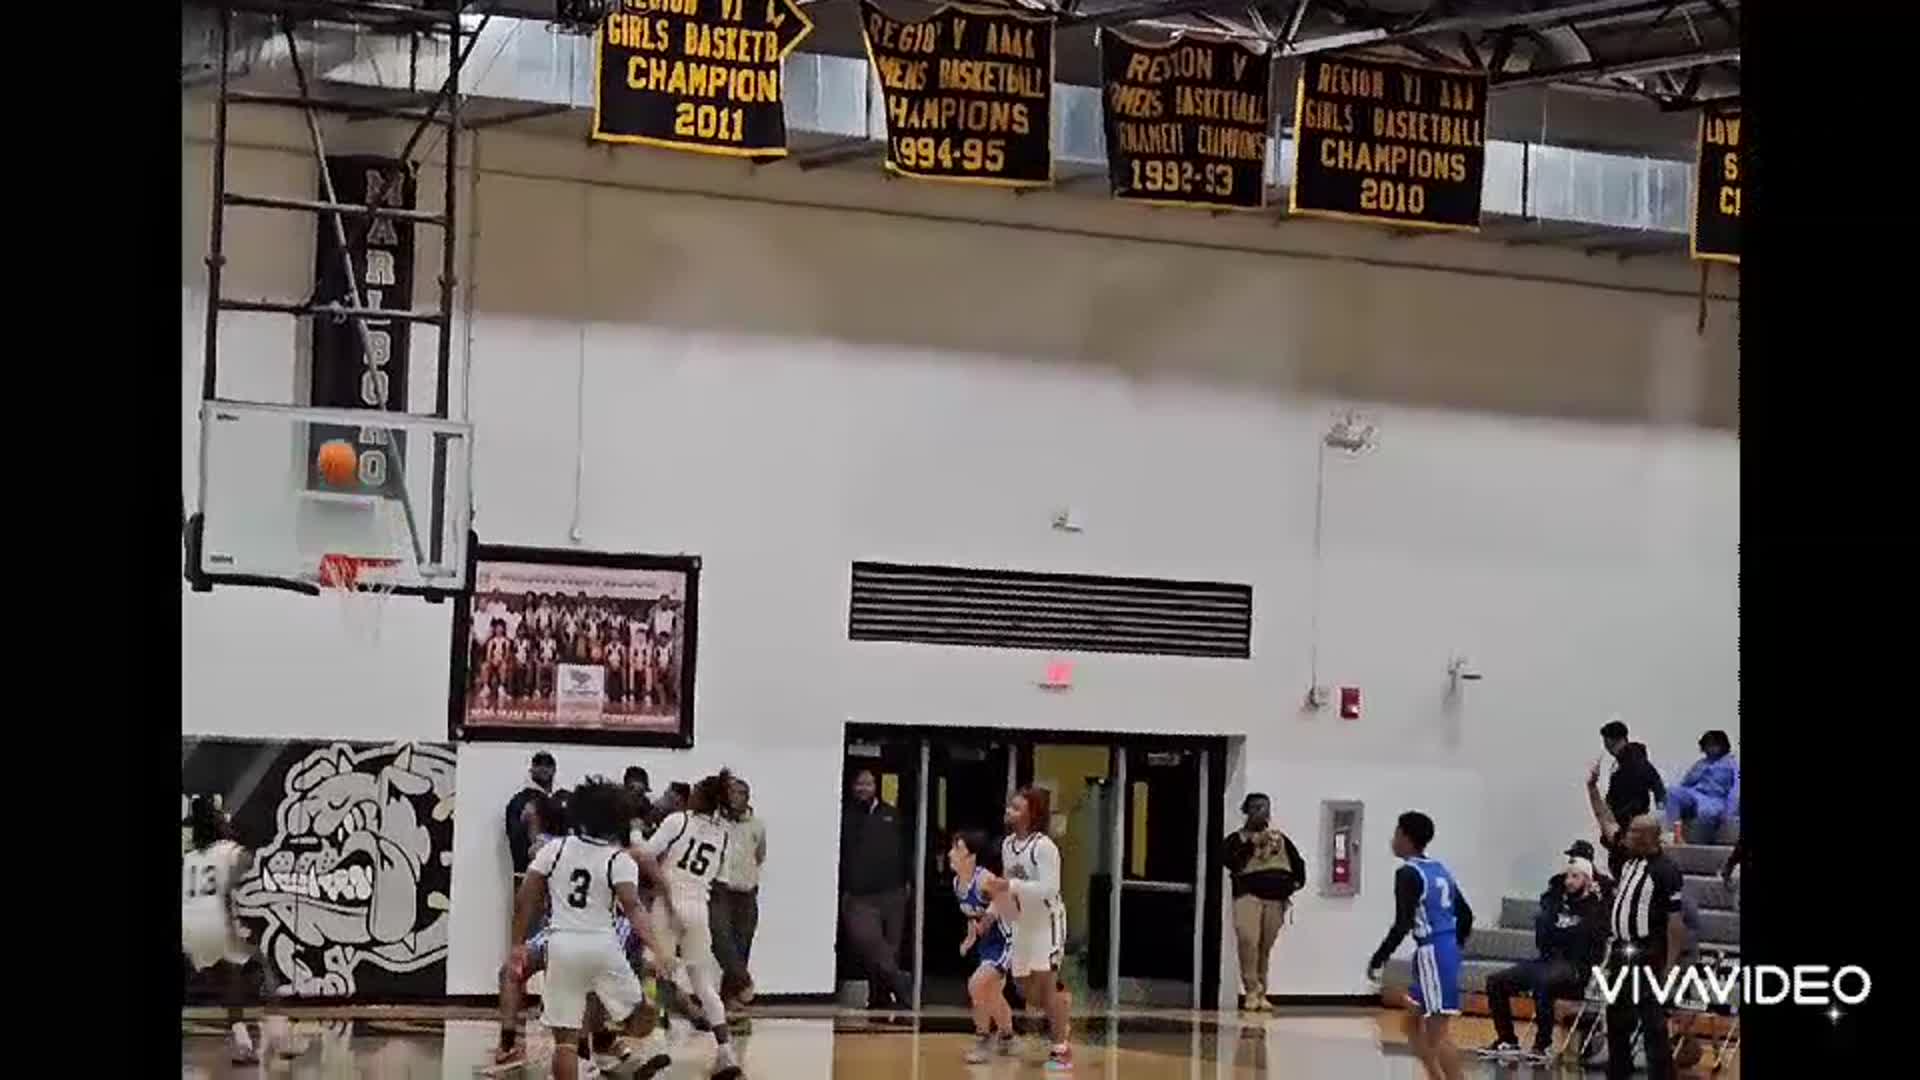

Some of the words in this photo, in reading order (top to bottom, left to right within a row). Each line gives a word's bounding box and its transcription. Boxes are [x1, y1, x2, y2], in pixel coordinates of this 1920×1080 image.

[608, 13, 669, 51] GIRLS
[1317, 62, 1385, 99] REGION
[1402, 73, 1422, 105] VI
[675, 102, 743, 141] 2011
[1305, 99, 1355, 134] GIRLS
[1373, 106, 1482, 147] BASKETBALL
[892, 135, 1005, 172] 1994-95
[1320, 137, 1467, 182] CHAMPIONS
[1131, 158, 1234, 196] 1992-93
[1360, 177, 1426, 214] 2010
[677, 837, 717, 877] 15
[567, 868, 592, 909] 3
